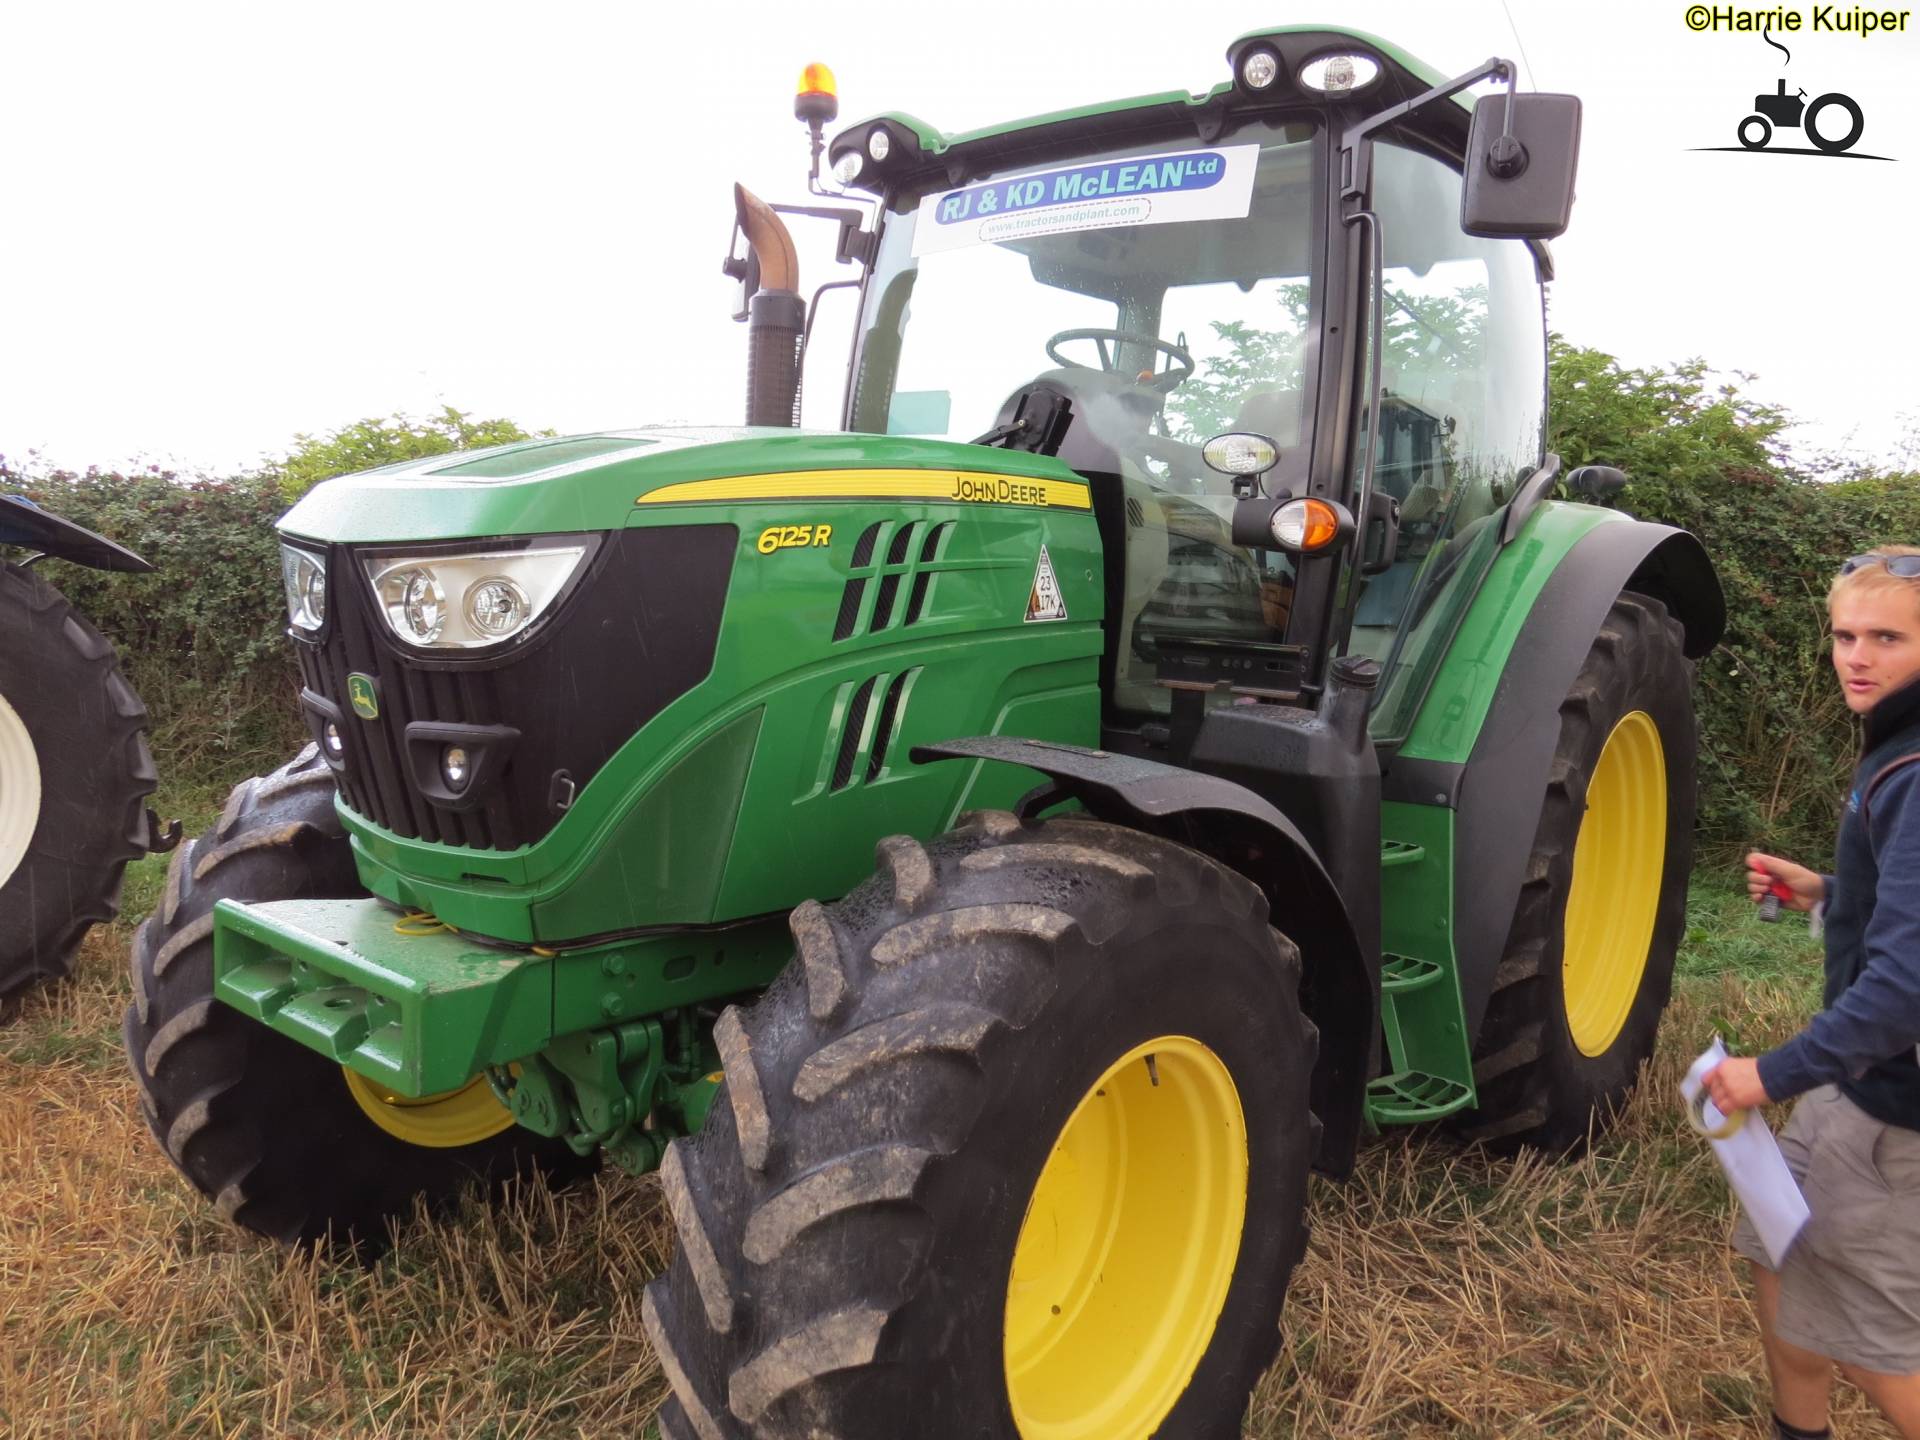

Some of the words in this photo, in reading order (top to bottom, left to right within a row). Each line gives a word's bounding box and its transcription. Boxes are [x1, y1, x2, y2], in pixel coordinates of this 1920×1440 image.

[942, 193, 973, 222] RJ
[976, 188, 999, 214] &
[1004, 179, 1046, 209] KD
[987, 204, 1140, 234] www.tractorsandplant.com
[951, 476, 996, 500] JOHN
[998, 479, 1048, 504] DEERE
